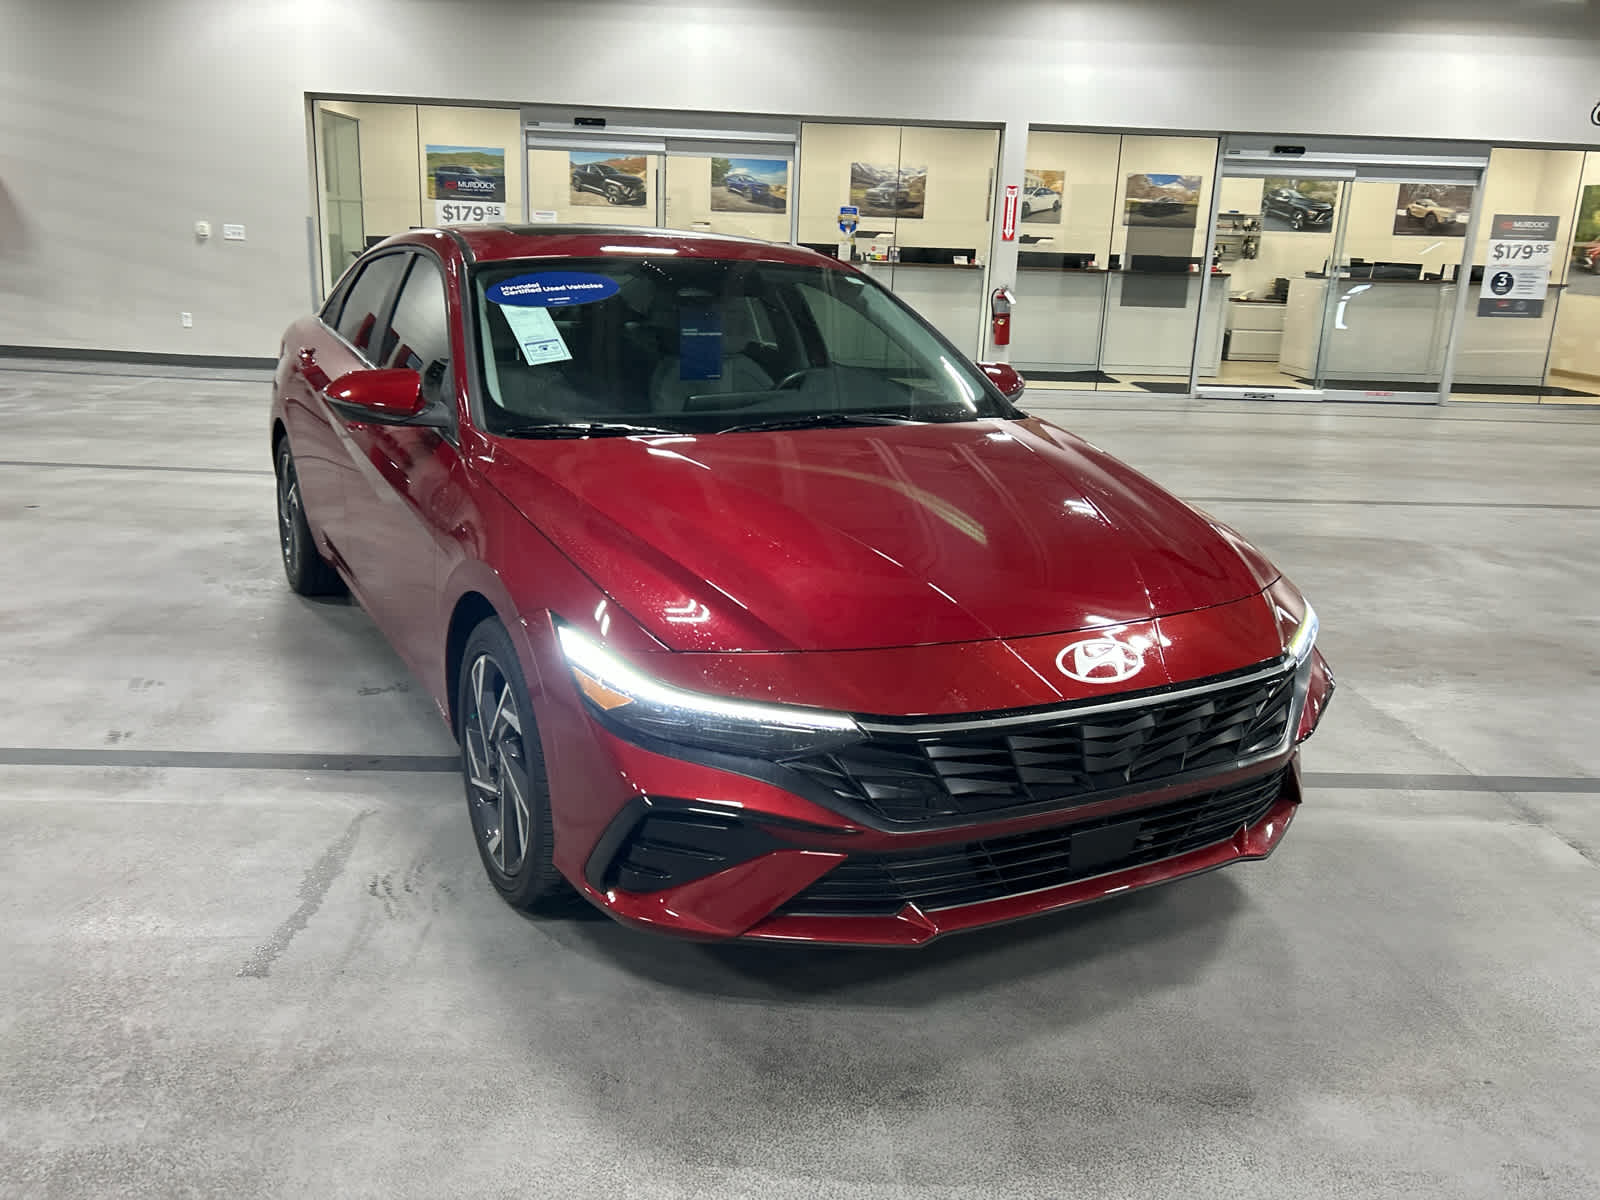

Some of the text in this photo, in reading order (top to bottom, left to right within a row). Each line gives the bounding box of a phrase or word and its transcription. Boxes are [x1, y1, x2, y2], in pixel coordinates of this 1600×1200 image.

[1497, 274, 1508, 286] 3
[542, 284, 566, 292] Used
[566, 282, 604, 291] Vehicles
